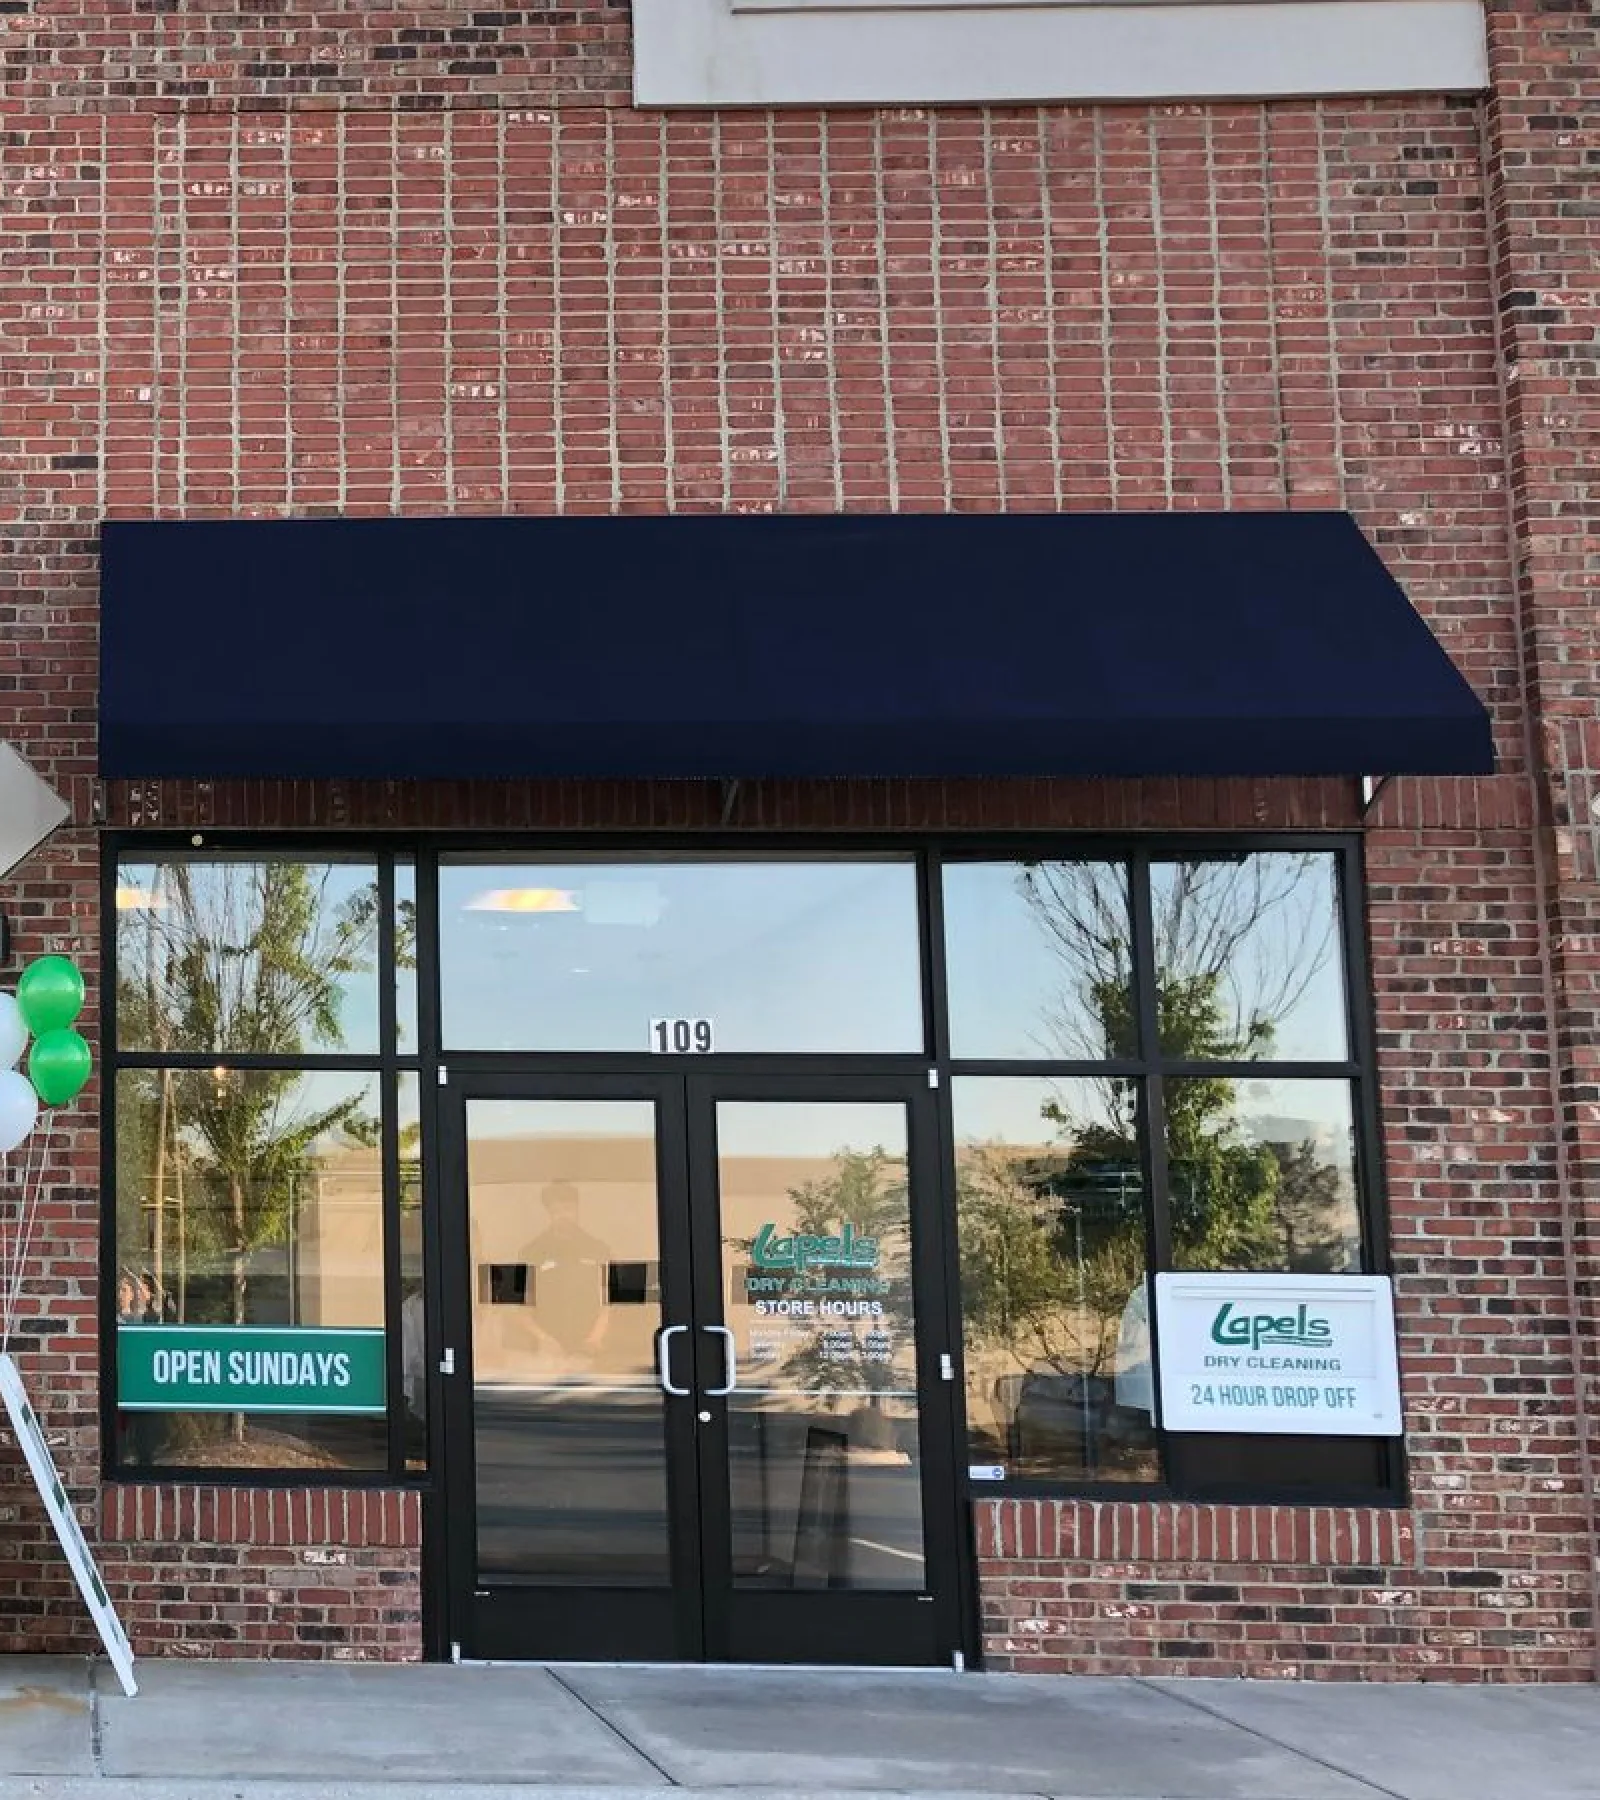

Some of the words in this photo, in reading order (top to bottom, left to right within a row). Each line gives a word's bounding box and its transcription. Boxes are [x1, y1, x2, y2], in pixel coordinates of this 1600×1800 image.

[654, 1020, 713, 1054] 109
[752, 1222, 881, 1272] Lapels
[745, 1277, 786, 1292] DRY
[755, 1300, 813, 1315] STORE
[819, 1300, 883, 1315] HOURS
[1211, 1302, 1333, 1350] Lapels
[153, 1350, 221, 1385] OPEN
[227, 1351, 350, 1387] SUNDAYS
[1203, 1355, 1240, 1368] DRY
[1246, 1355, 1342, 1371] CLEANING
[1190, 1383, 1214, 1405] 24
[1218, 1384, 1268, 1407] HOUR
[1272, 1385, 1319, 1408] DROP
[1324, 1387, 1357, 1409] OFF
